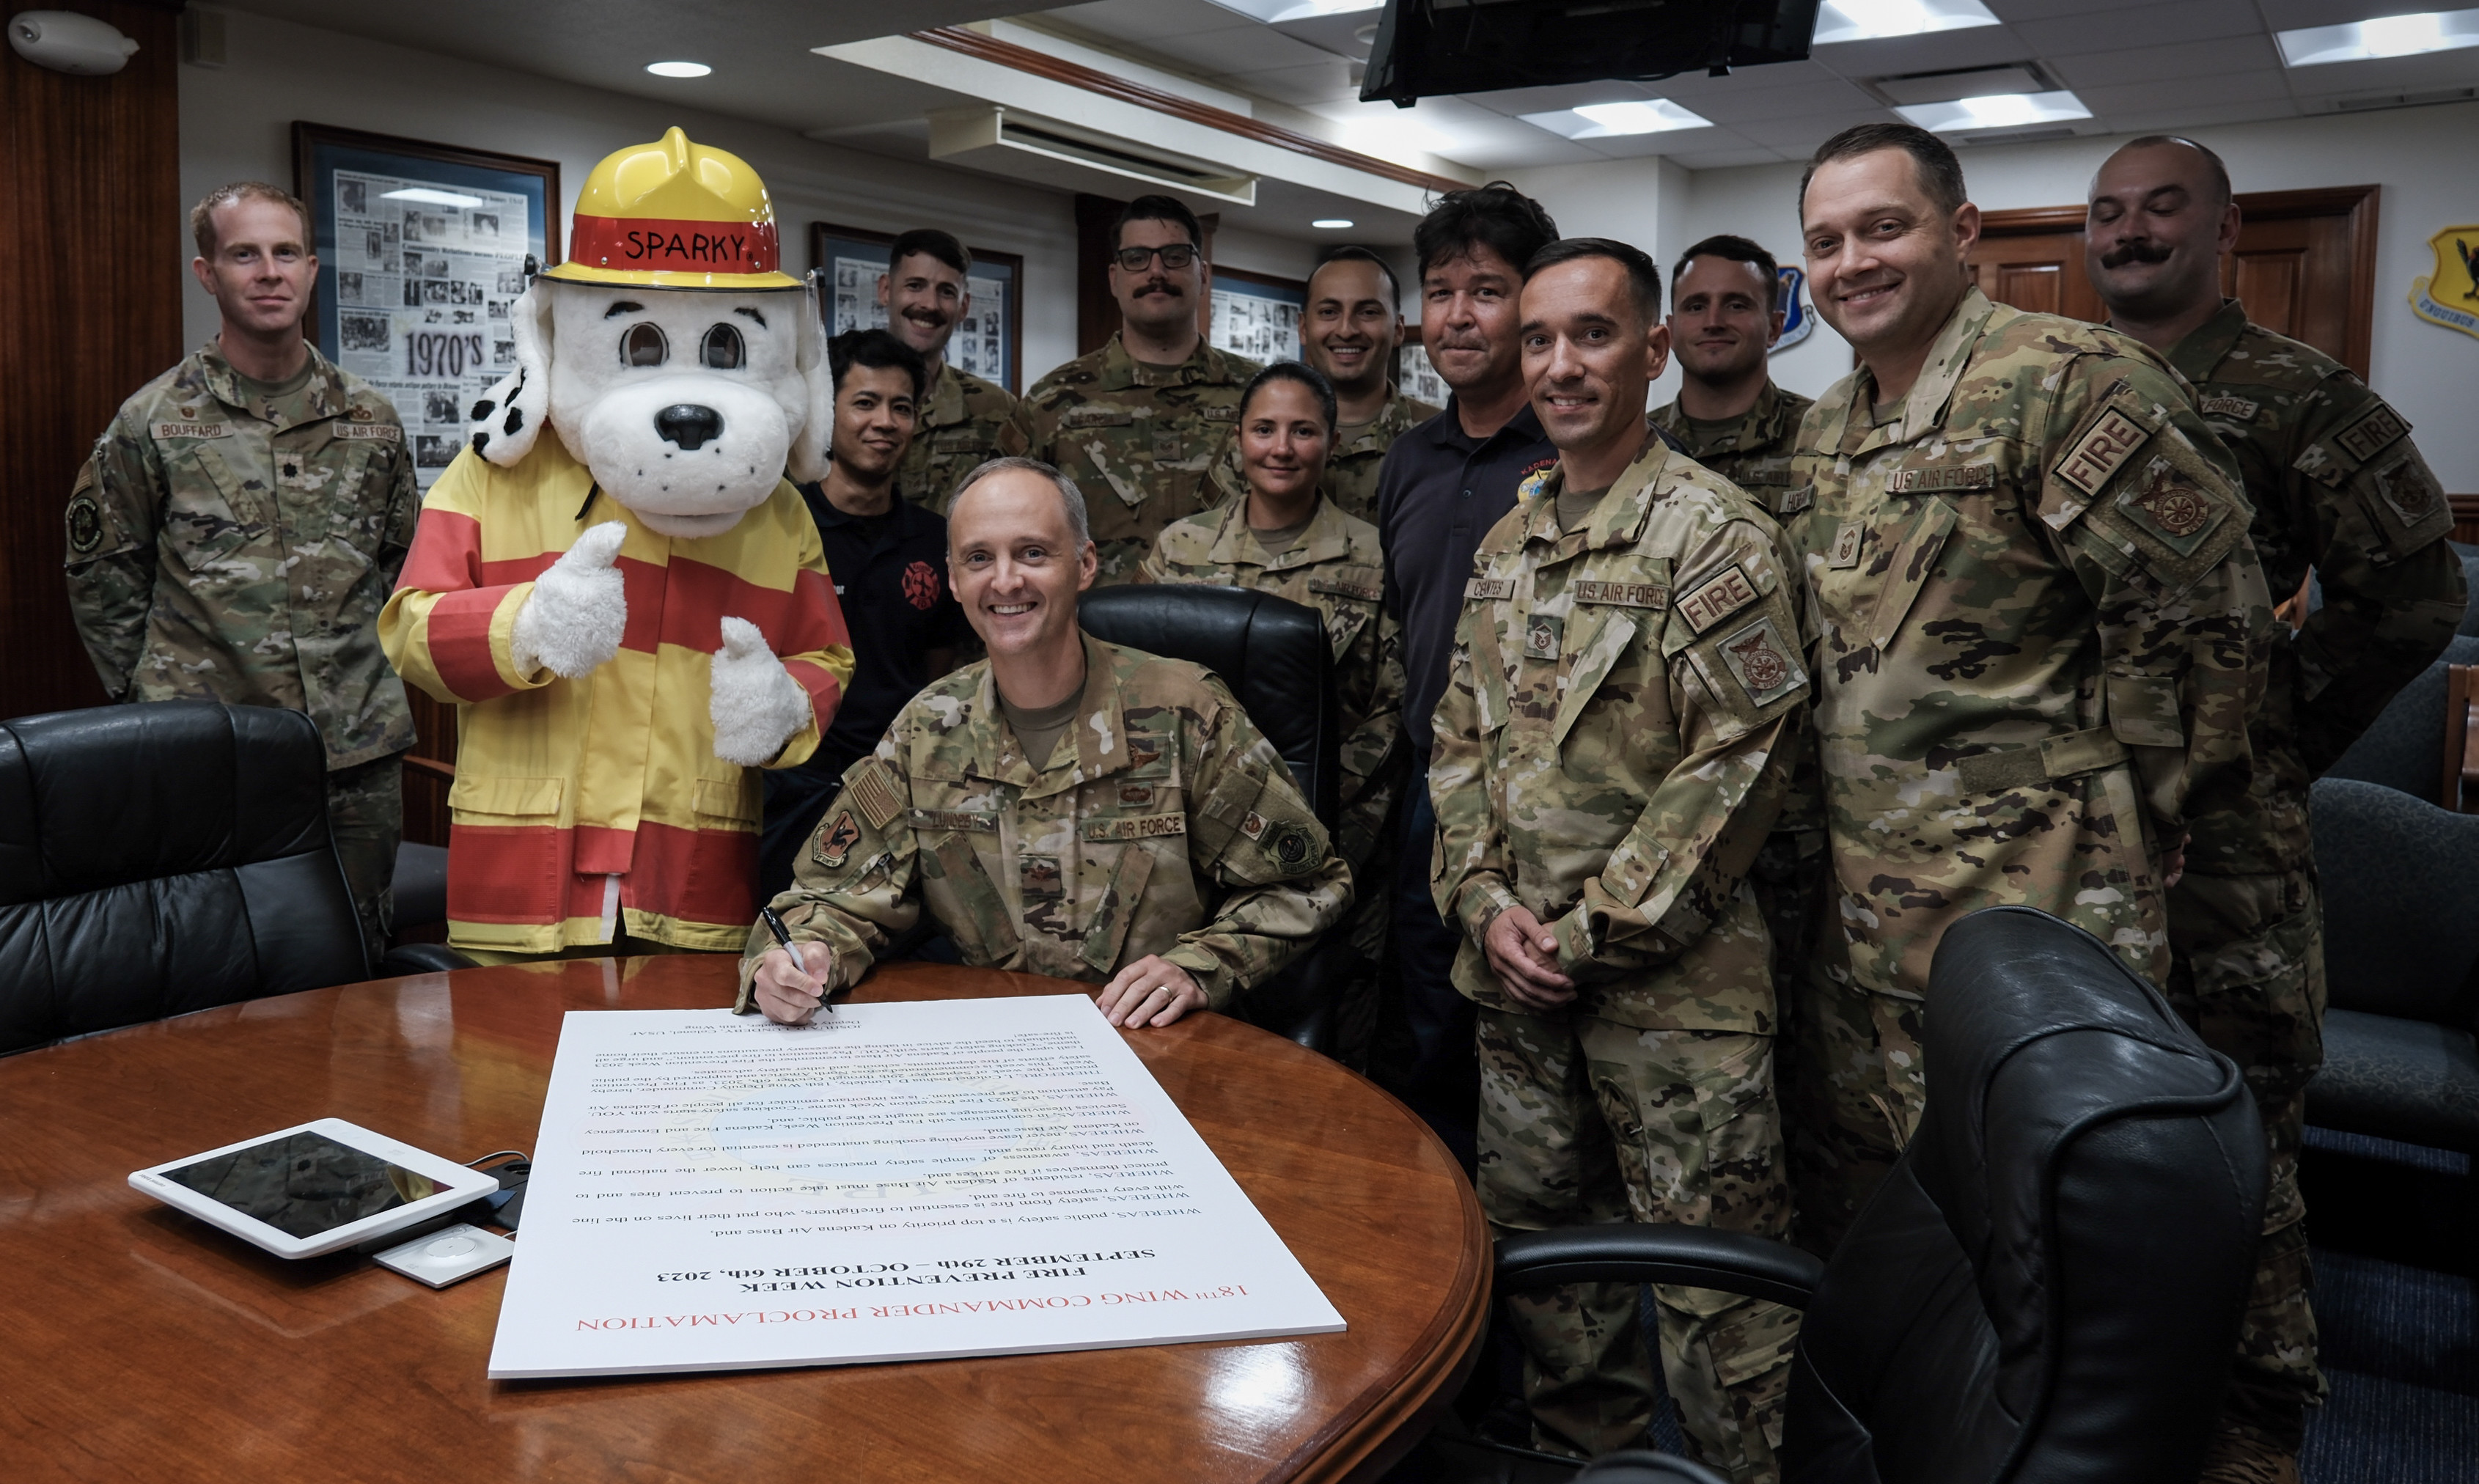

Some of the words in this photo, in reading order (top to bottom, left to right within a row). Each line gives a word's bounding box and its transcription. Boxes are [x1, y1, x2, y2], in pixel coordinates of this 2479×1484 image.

[625, 230, 745, 263] SPARKY
[2419, 298, 2475, 328] UNGUIBUS
[405, 331, 484, 377] 1970'S
[2203, 398, 2253, 417] FORCE
[161, 423, 222, 438] BOUFFARD
[352, 426, 369, 438] AIR
[370, 426, 400, 441] FORCE
[2345, 414, 2401, 458] FIRE
[2065, 418, 2141, 490] FIRE
[1520, 458, 1557, 476] KADENA
[1917, 469, 1941, 488] AIR
[1601, 584, 1623, 602] AIR
[1627, 586, 1665, 606] FORCE
[1683, 573, 1752, 628] FIRE
[933, 812, 980, 828] LUNDEBY
[1088, 823, 1109, 839] U.S.
[1115, 820, 1136, 838] AIR
[1139, 817, 1182, 836] FORCE
[721, 1144, 779, 1152] essential
[798, 1141, 870, 1149] unattended
[818, 1160, 878, 1168] practices
[932, 1156, 976, 1164] simple
[1123, 1161, 1168, 1169] protect
[1045, 1164, 1120, 1173] themselves
[669, 1188, 722, 1196] prevent
[1048, 1188, 1109, 1196] response
[909, 1203, 969, 1212] essential
[736, 1211, 759, 1219] put
[1064, 1211, 1108, 1222] public
[818, 1224, 873, 1233] Kadena
[902, 1219, 956, 1229] priority
[937, 1259, 987, 1269] 29th
[994, 1249, 1156, 1266] SEPTEMBER
[657, 1271, 711, 1282] 2023
[719, 1269, 765, 1279] 6th,
[773, 1263, 909, 1277] OCTOBER
[1023, 1267, 1086, 1279] FIRE
[740, 1280, 826, 1293] WEEK
[836, 1271, 1016, 1288] PREVENTION
[1101, 1289, 1189, 1305] WING
[869, 1295, 1092, 1318] COMMANDER
[577, 1307, 857, 1331] PROCLAMATION
